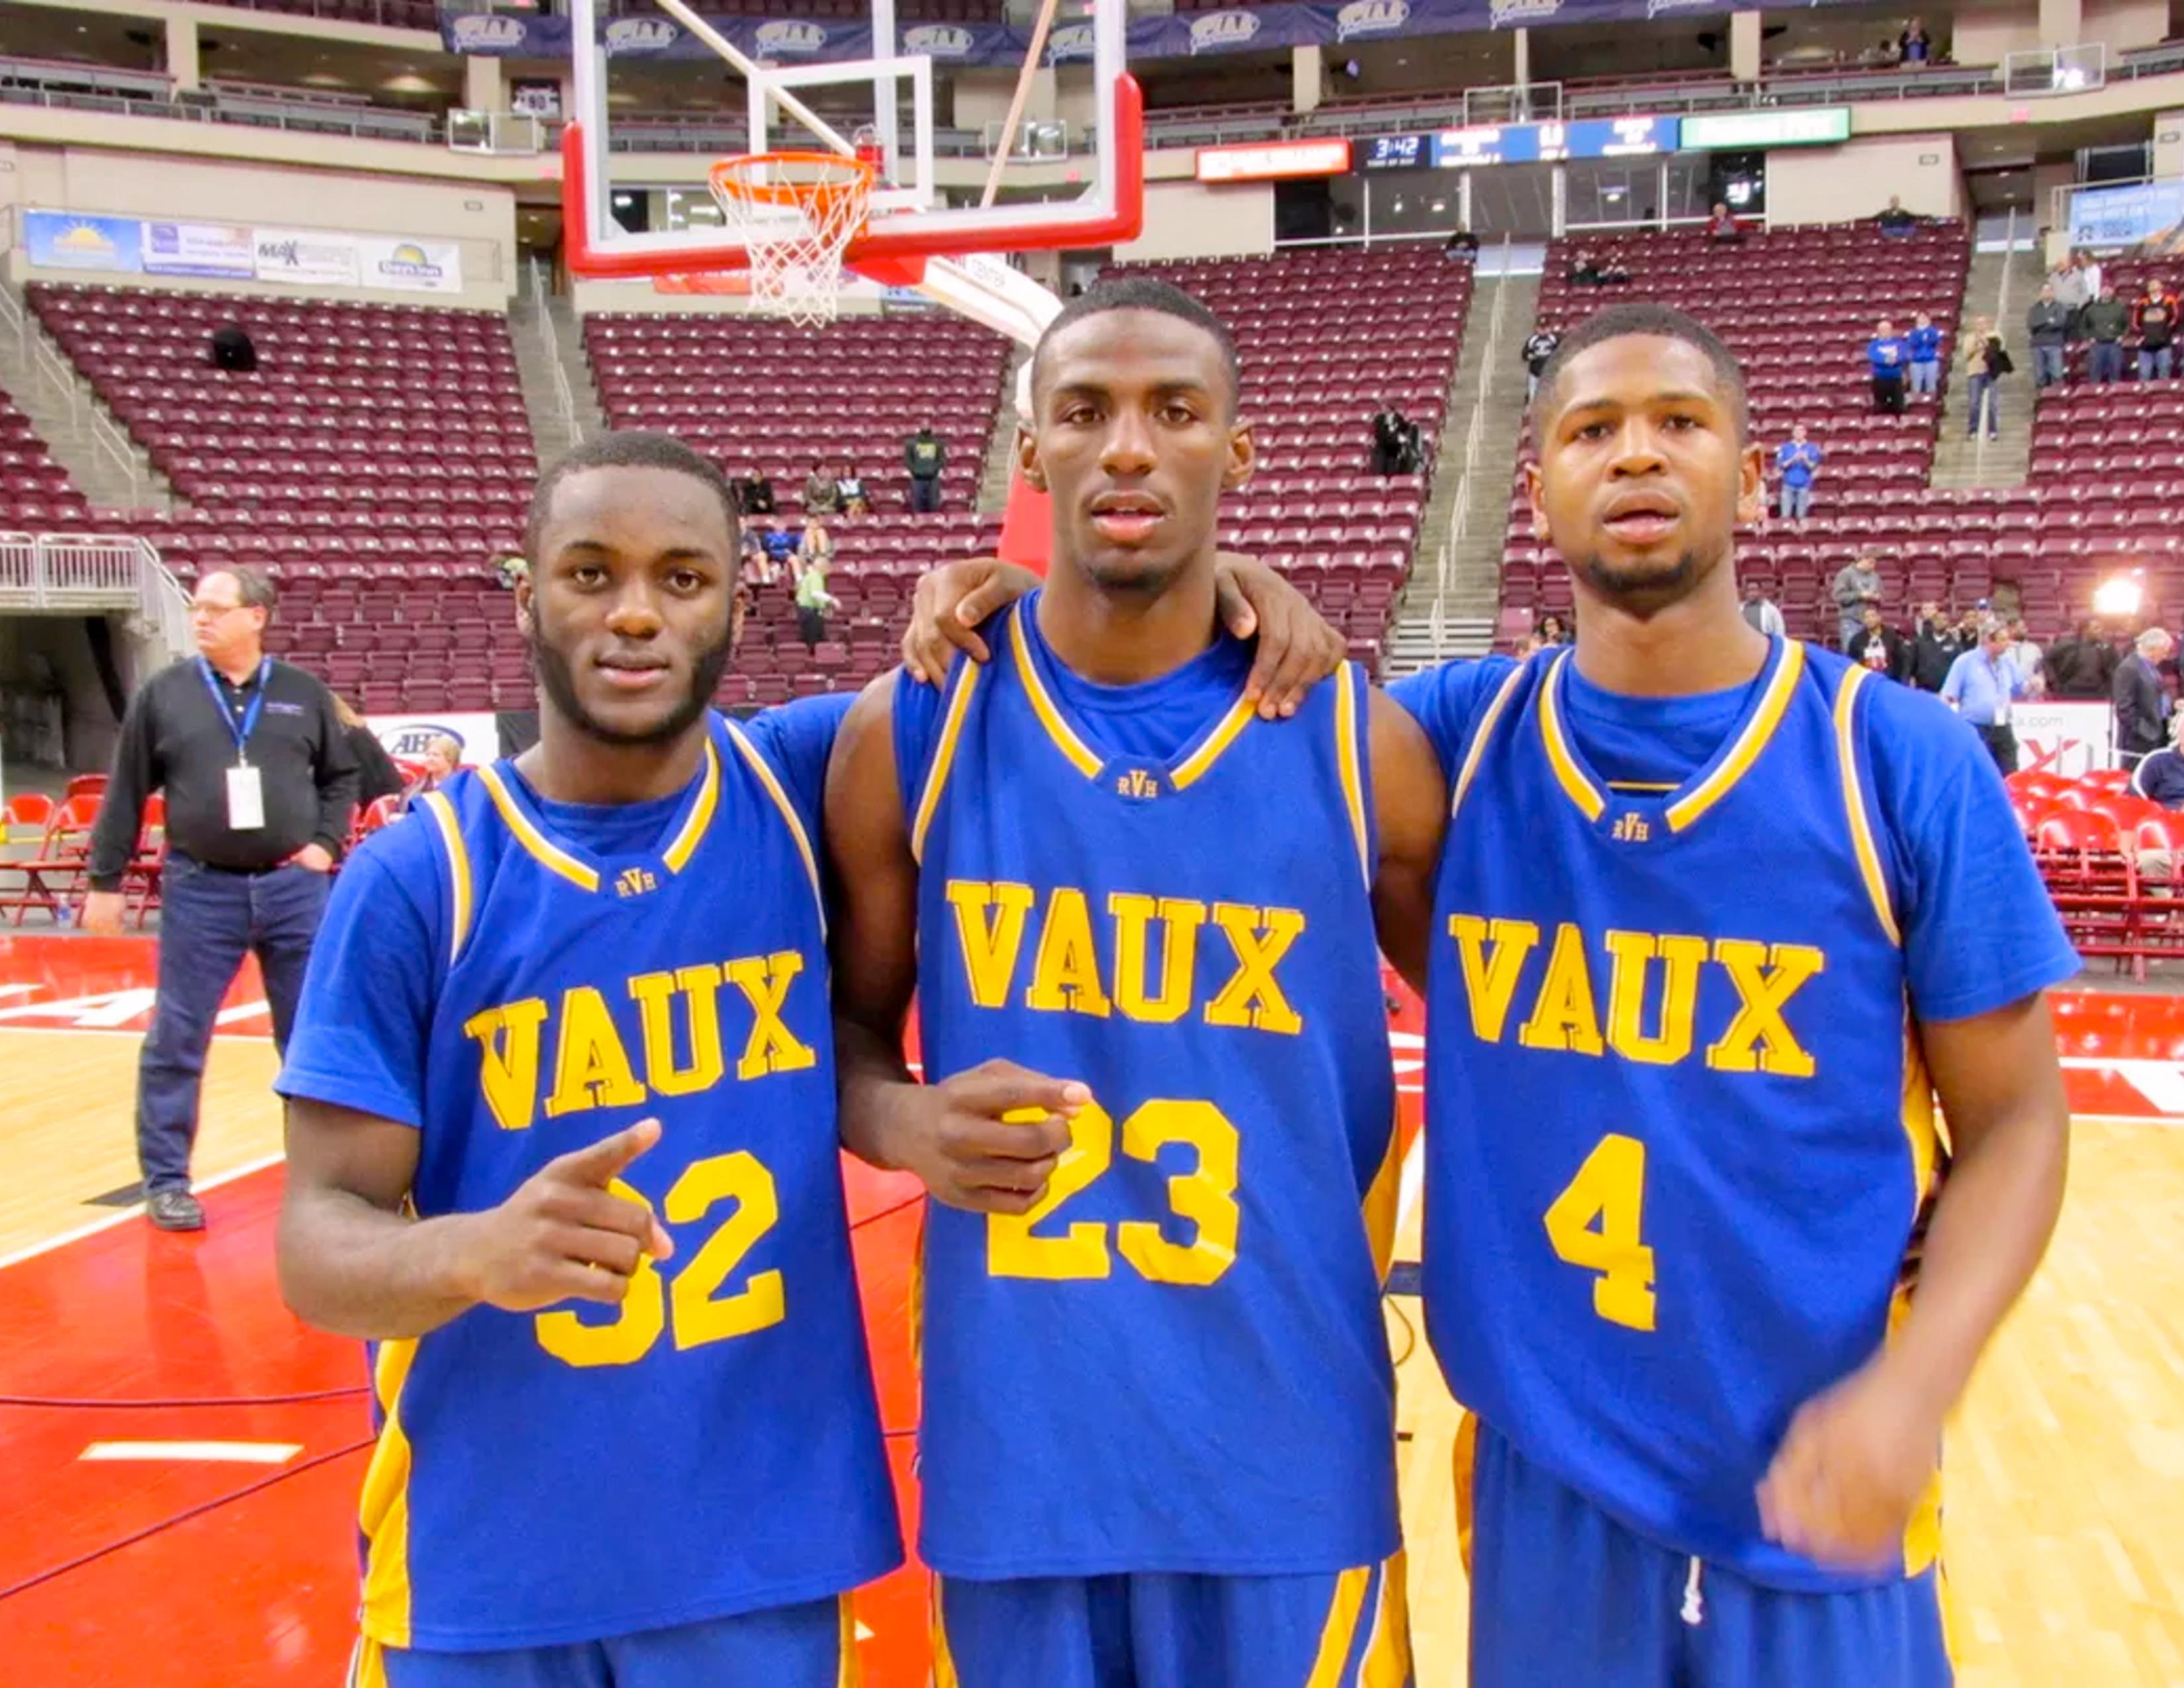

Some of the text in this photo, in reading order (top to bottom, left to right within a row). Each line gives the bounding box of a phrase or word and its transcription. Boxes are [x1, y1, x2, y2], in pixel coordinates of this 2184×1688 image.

[1376, 136, 1419, 158] 3:42
[465, 949, 816, 1130] VAUX
[946, 878, 1306, 1035] VAUX
[1448, 913, 1825, 1078] VAUX
[987, 1096, 1240, 1286] 23
[1543, 1133, 1657, 1333] 4
